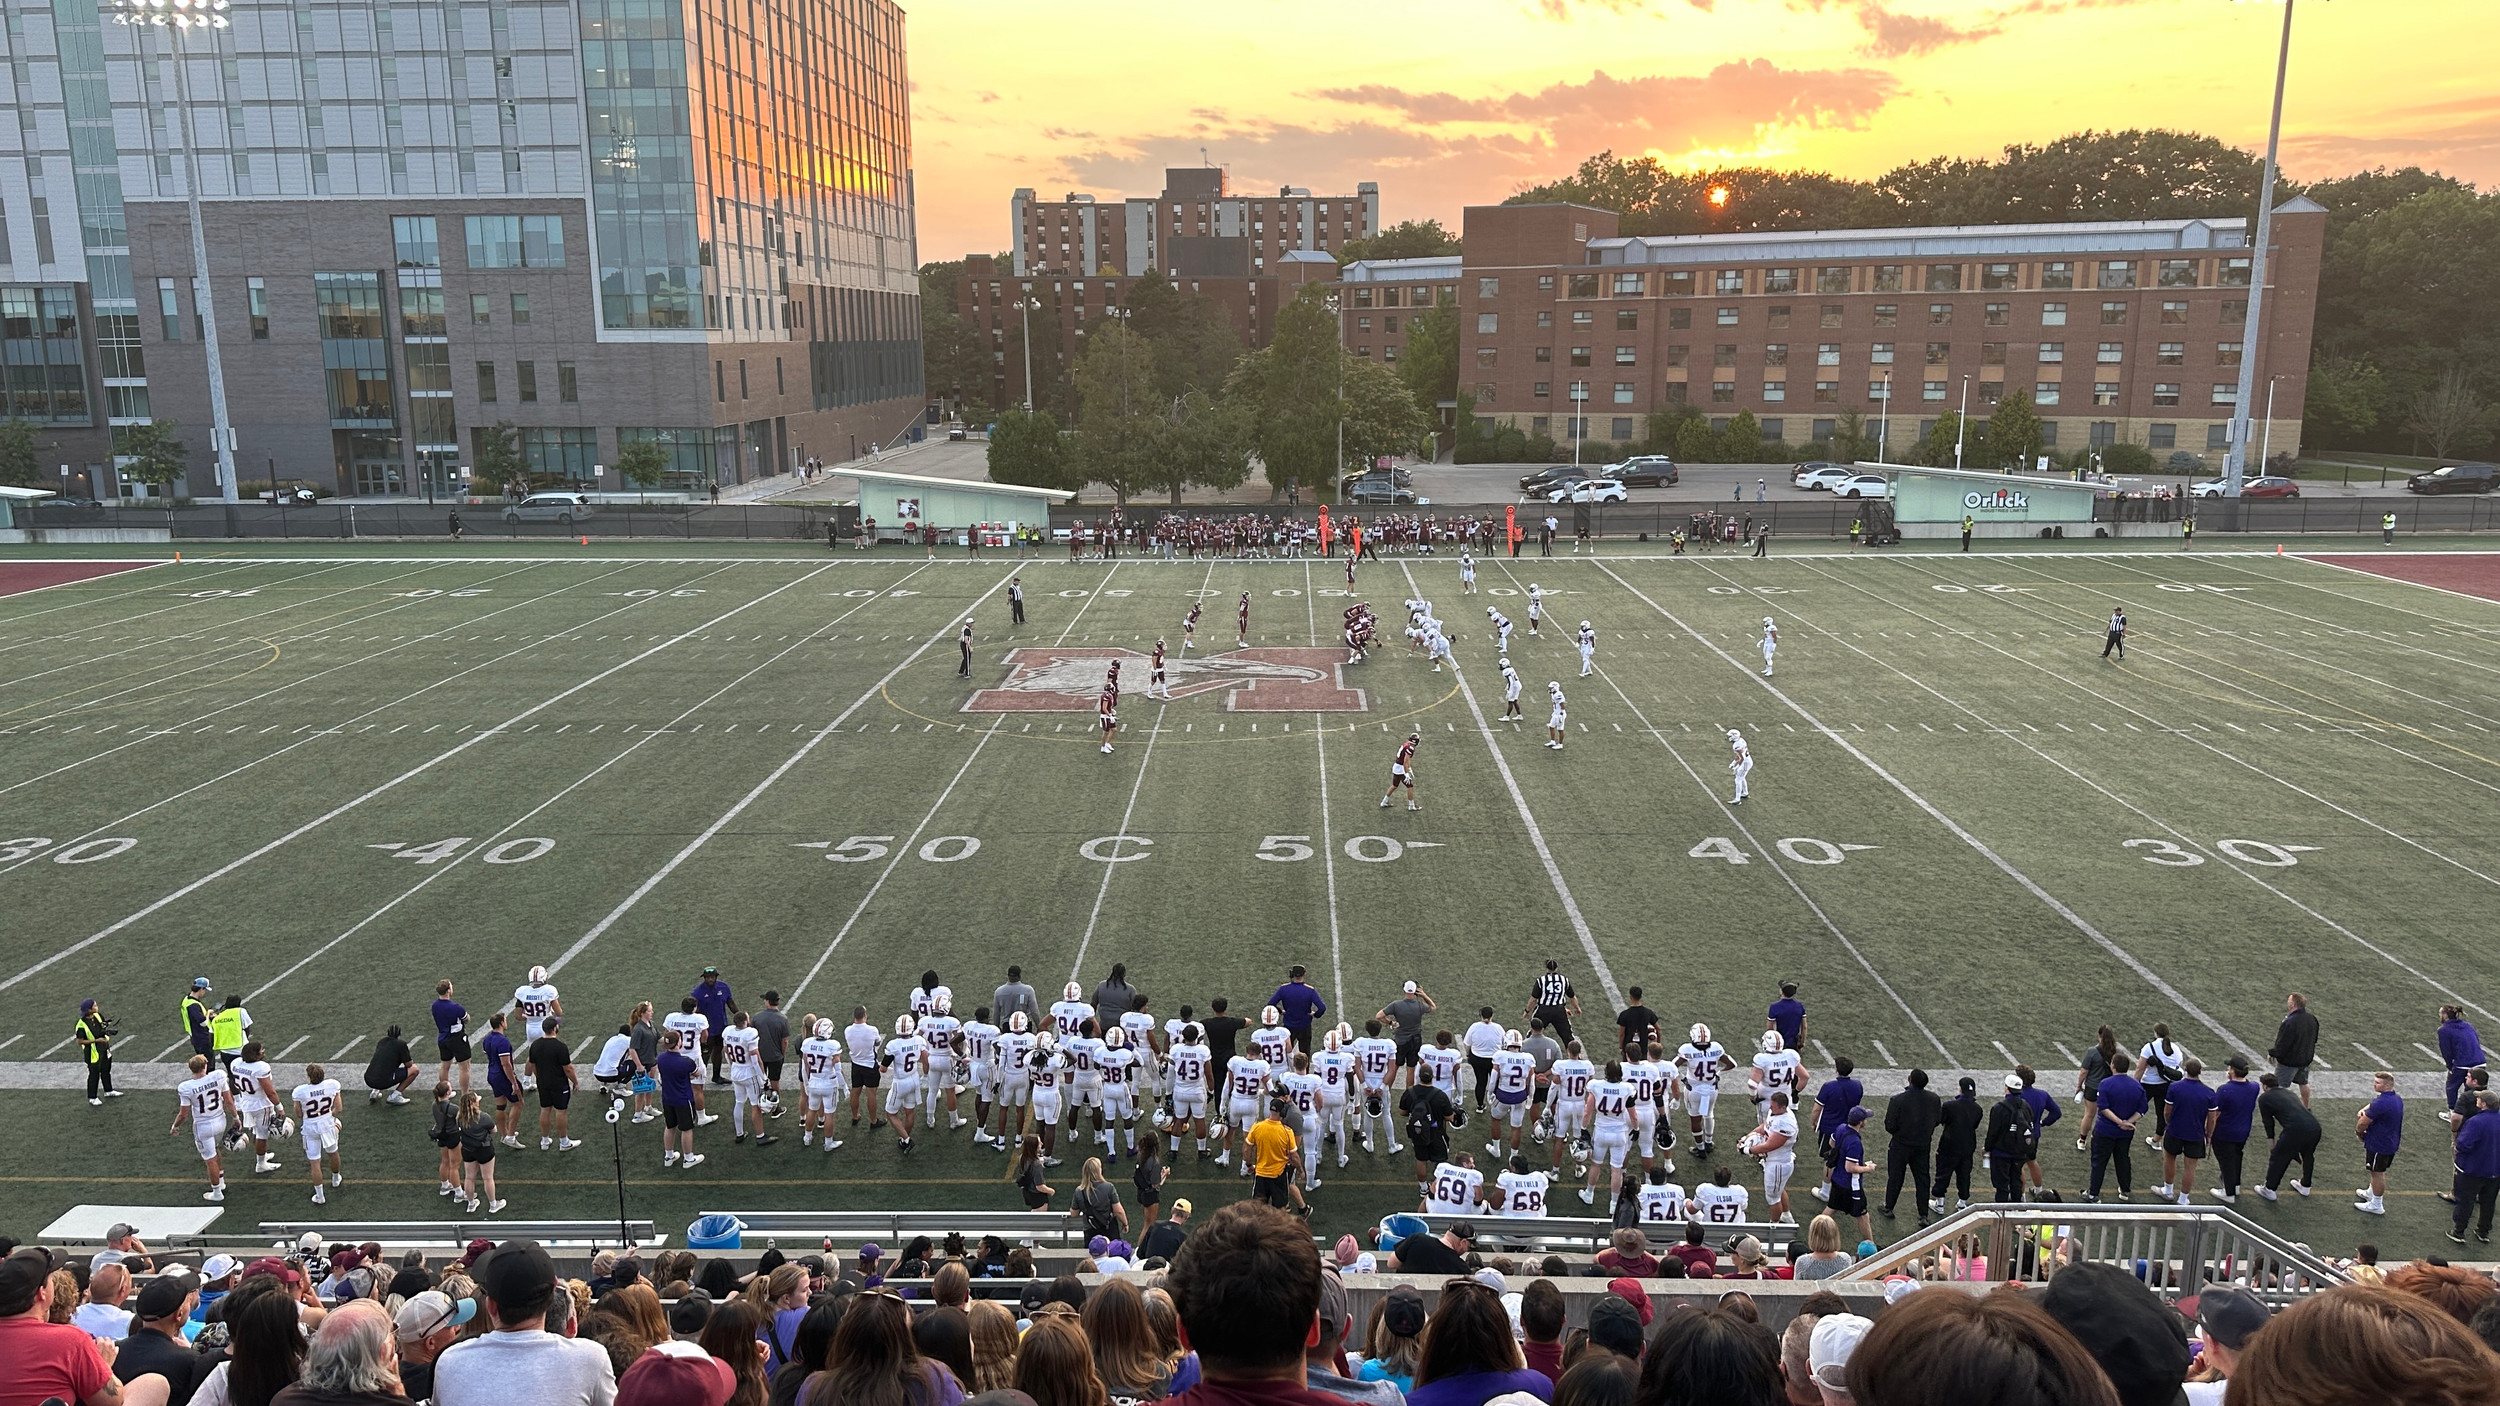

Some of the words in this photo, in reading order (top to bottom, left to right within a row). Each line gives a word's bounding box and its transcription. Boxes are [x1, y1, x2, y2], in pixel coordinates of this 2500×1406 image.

[1964, 489, 2029, 509] Orlick
[405, 589, 493, 598] 20
[624, 589, 706, 597] 30
[843, 589, 921, 598] 40
[1059, 589, 1134, 598] 50
[1185, 589, 1222, 598] C
[1707, 586, 1788, 595] 30
[1932, 584, 2018, 593] 20
[0, 837, 138, 864] 30
[392, 837, 556, 864] 40
[825, 835, 981, 863] 50
[1079, 835, 1154, 863] C
[1255, 835, 1403, 863] 50
[1688, 836, 1845, 865] 40
[2122, 838, 2298, 867] 30
[1546, 982, 1563, 994] 43
[523, 1002, 547, 1017] 98
[1058, 1016, 1079, 1035] 94
[927, 1031, 948, 1048] 42
[969, 1037, 982, 1058] 11
[808, 1053, 827, 1073] 27
[904, 1053, 915, 1072] 6
[1014, 1048, 1024, 1068] 3
[1078, 1053, 1088, 1070] 0
[1261, 1043, 1284, 1064] 83
[1366, 1053, 1387, 1073] 15
[1031, 1072, 1053, 1087] 29
[1101, 1065, 1122, 1084] 38
[1177, 1060, 1200, 1080] 43
[1327, 1067, 1338, 1085] 8
[1435, 1063, 1441, 1081] 1
[1509, 1066, 1522, 1086] 2
[1694, 1061, 1717, 1081] 45
[1769, 1068, 1792, 1088] 54
[1235, 1076, 1260, 1095] 32
[1567, 1076, 1586, 1097] 10
[197, 1089, 221, 1114] 13
[306, 1096, 333, 1118] 22
[1597, 1096, 1622, 1116] 44
[1438, 1176, 1466, 1206] 69
[1513, 1191, 1541, 1211] 68
[1649, 1201, 1677, 1221] 64
[1710, 1204, 1738, 1222] 67
